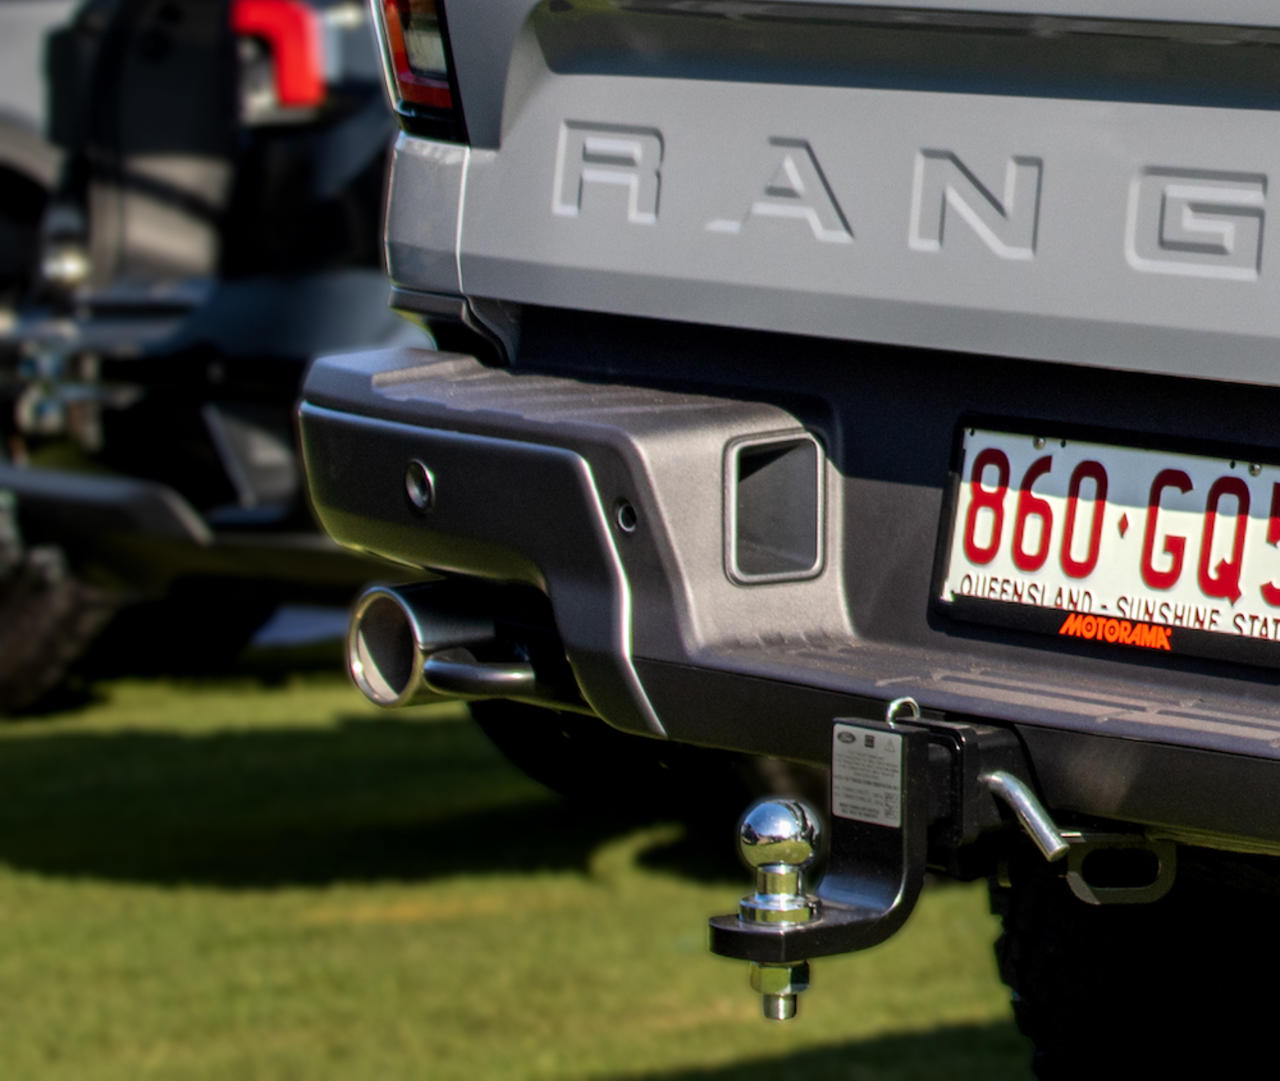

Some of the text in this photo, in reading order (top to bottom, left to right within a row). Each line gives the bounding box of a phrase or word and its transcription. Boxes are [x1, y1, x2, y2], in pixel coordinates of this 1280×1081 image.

[960, 573, 1094, 611] QUEENSLAND
[1117, 595, 1220, 631] SUNSHINE
[1059, 612, 1172, 651] MOTORAMA
